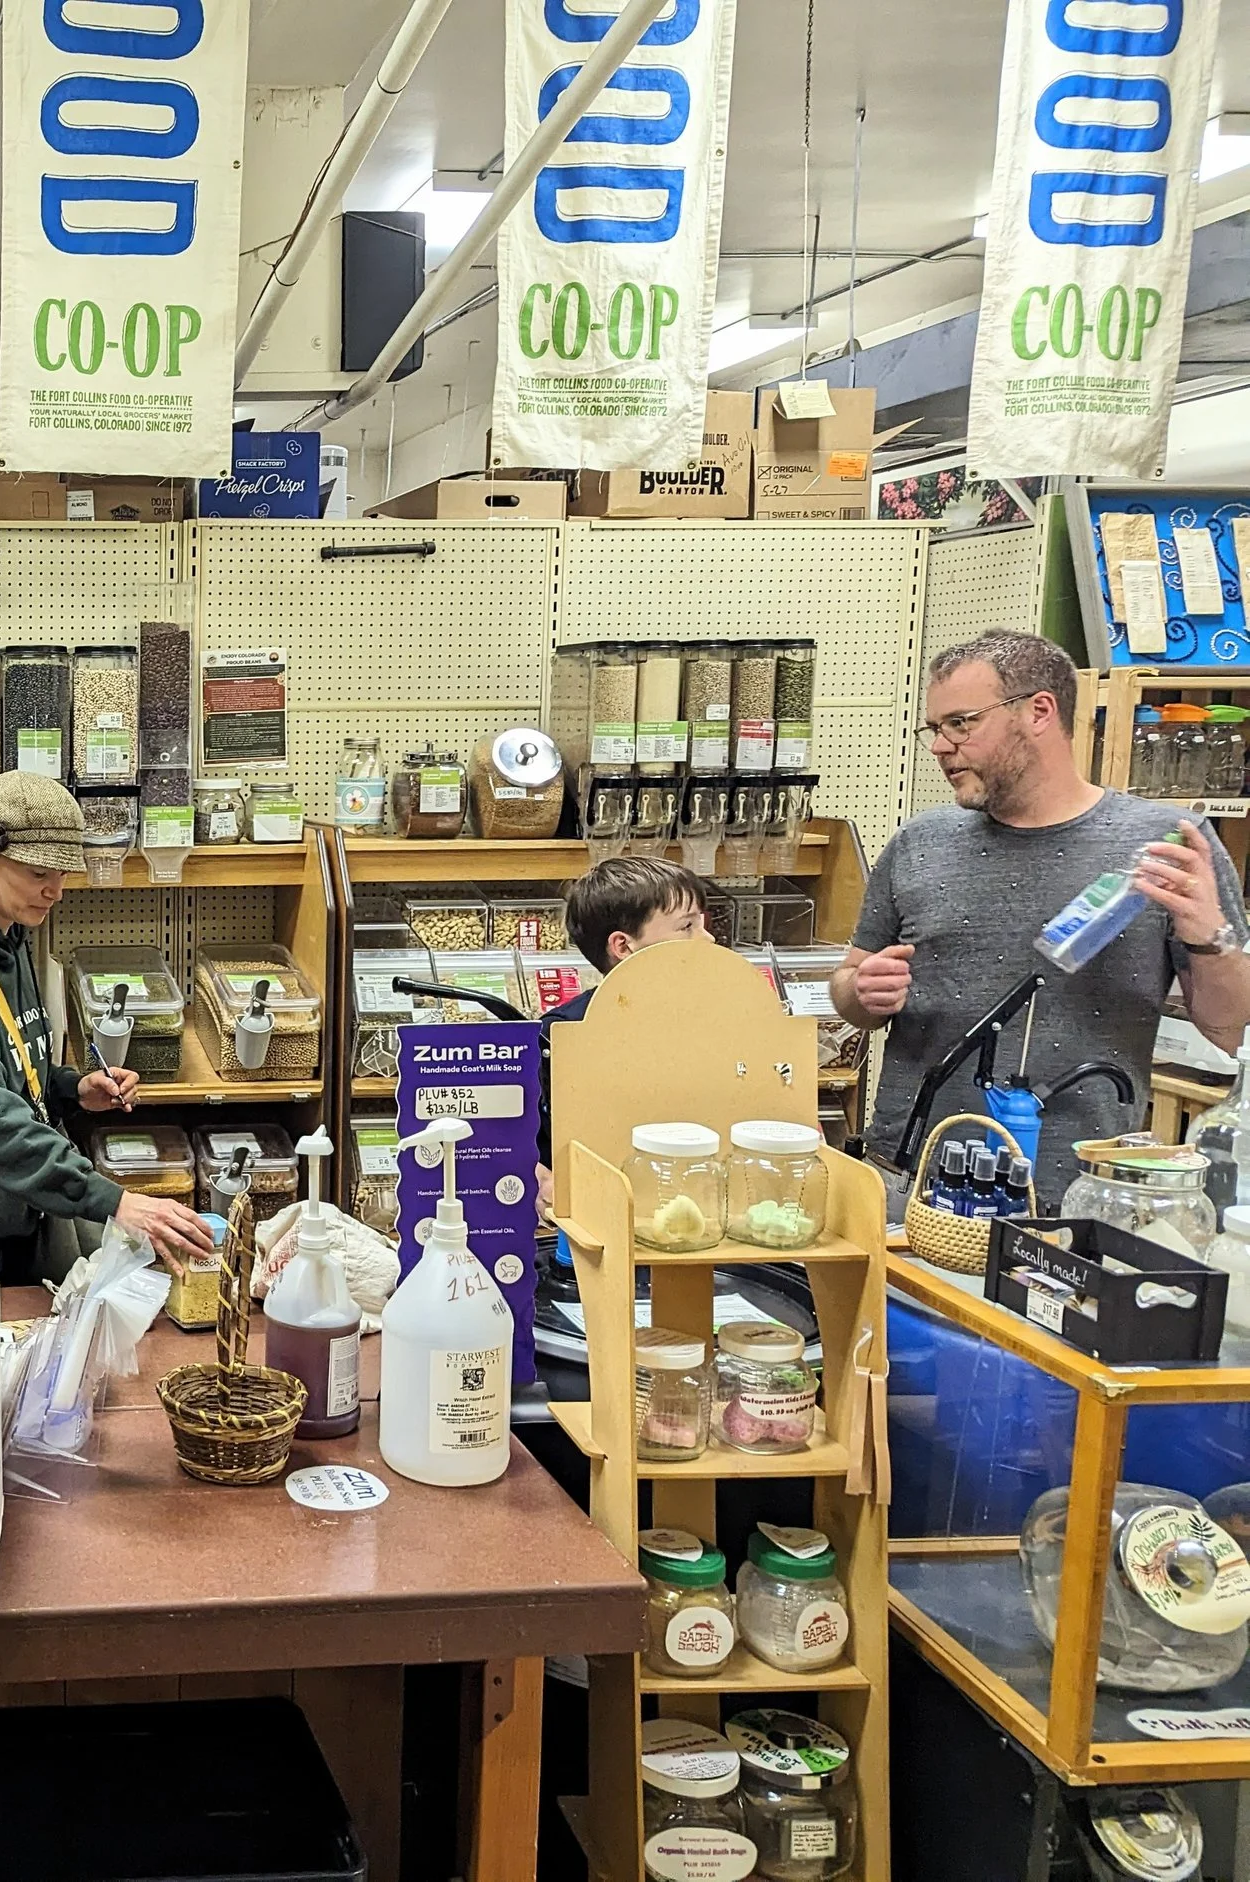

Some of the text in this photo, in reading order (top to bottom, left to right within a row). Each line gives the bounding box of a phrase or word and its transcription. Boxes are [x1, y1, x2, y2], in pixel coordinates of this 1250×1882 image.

[518, 282, 678, 360] CO-OP
[1011, 282, 1161, 362] CO-OP
[34, 298, 202, 377] CO-OP
[30, 390, 193, 406] THE FORT COLLINS FOOD CO-OPERATIVE
[29, 417, 192, 432] FORT COLLINS, COLORADO SINCE 1972
[703, 434, 729, 445] OULDER.
[214, 474, 305, 501] Pretzel Crisps
[520, 937, 537, 946] EQUAL
[414, 1044, 524, 1062] Zum Bar
[503, 1064, 522, 1073] Soap
[418, 1088, 475, 1100] PLU# 852
[1013, 1236, 1087, 1287] Locally made!
[447, 1349, 500, 1361] STARWEST
[679, 1631, 722, 1643] RABBIT
[802, 1621, 838, 1640] RABBIT
[678, 1641, 720, 1654] BRUSH
[657, 1847, 685, 1855] Organic
